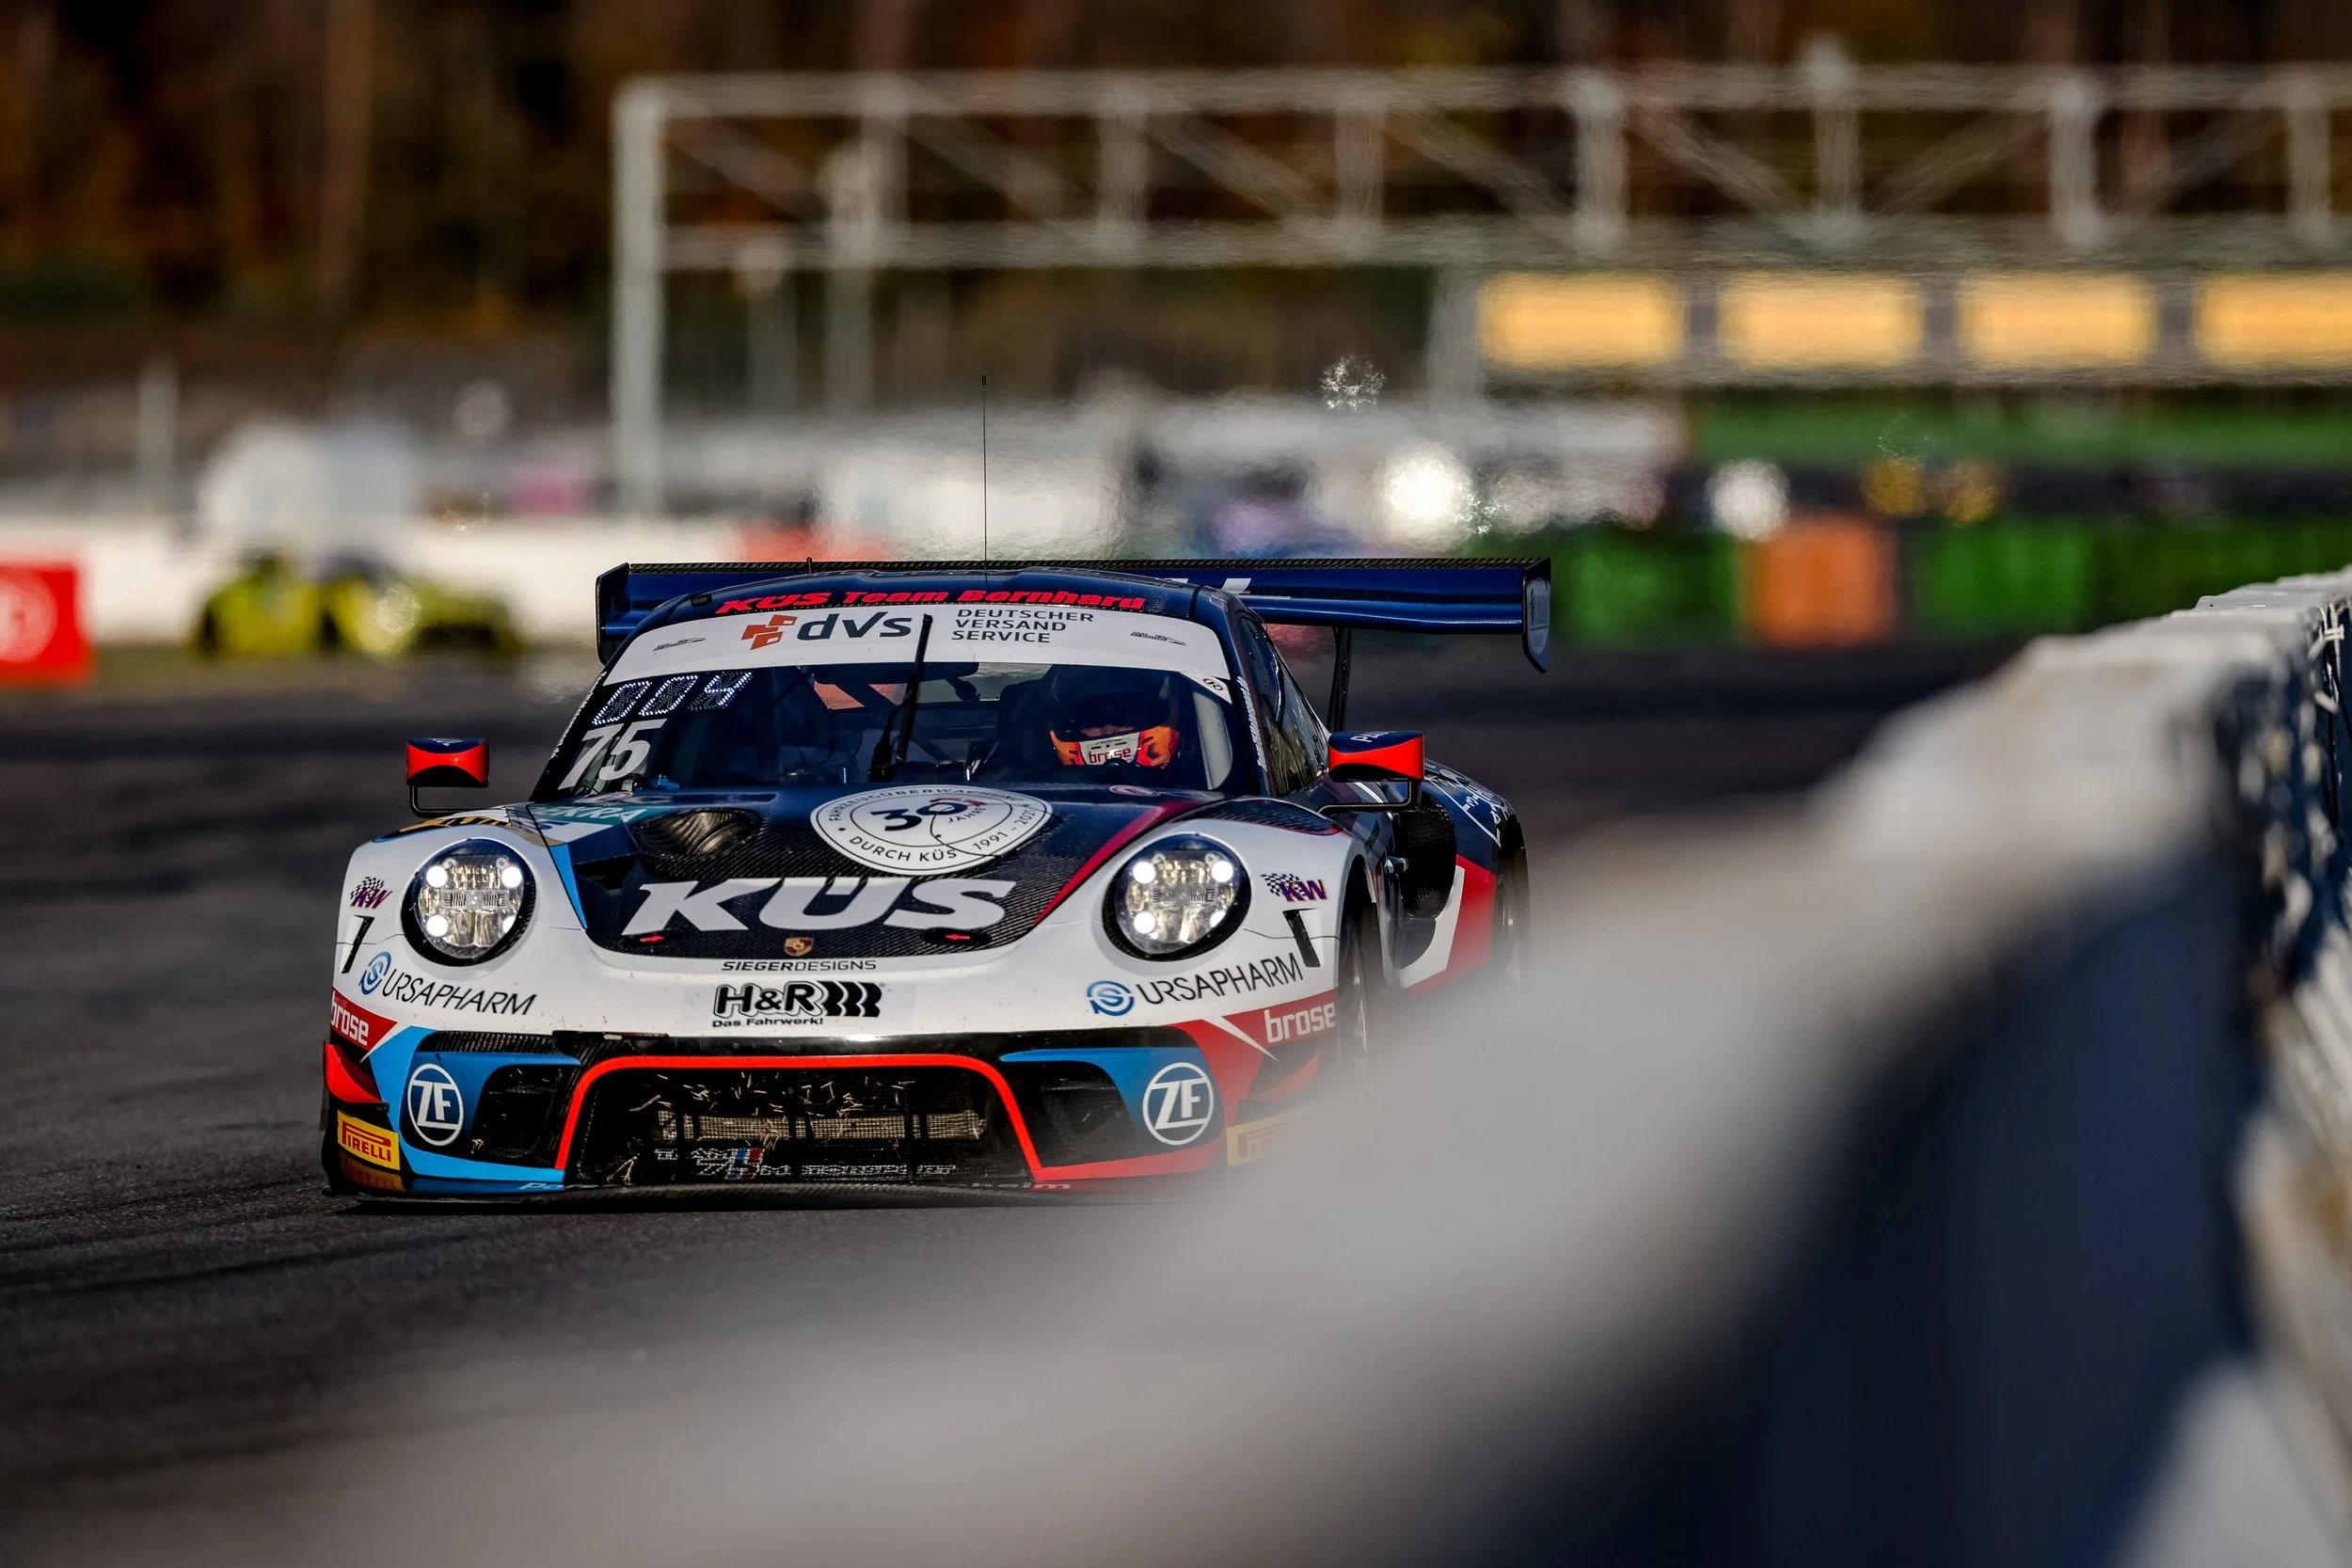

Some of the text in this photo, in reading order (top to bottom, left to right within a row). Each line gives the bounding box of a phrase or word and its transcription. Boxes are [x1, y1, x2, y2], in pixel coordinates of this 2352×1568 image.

[715, 590, 1146, 614] KÜS Team Bernhard
[958, 609, 1094, 622] DEUTSCHER
[797, 611, 913, 641] dvs
[951, 629, 1051, 643] SERVICE
[955, 619, 1067, 631] VERSAND
[557, 718, 668, 791] 75
[869, 800, 968, 832] 30
[946, 806, 987, 824] JAHRE
[849, 834, 912, 862] DURCH
[918, 848, 958, 863] KÜS
[971, 831, 1009, 850] 1991
[621, 877, 1016, 935] KÜS
[1278, 879, 1328, 903] KW
[721, 959, 877, 972] SIEGERDESIGNS
[1136, 951, 1304, 1006] URSAPHARM
[382, 968, 538, 1016] URSAPHARM
[714, 981, 822, 1018] H&R
[711, 1017, 824, 1028] Das Fahrwerk!
[1263, 1002, 1338, 1044] brose
[409, 1076, 461, 1132] ZF
[1148, 1075, 1210, 1132] ZF
[342, 1119, 392, 1163] PIRELLI
